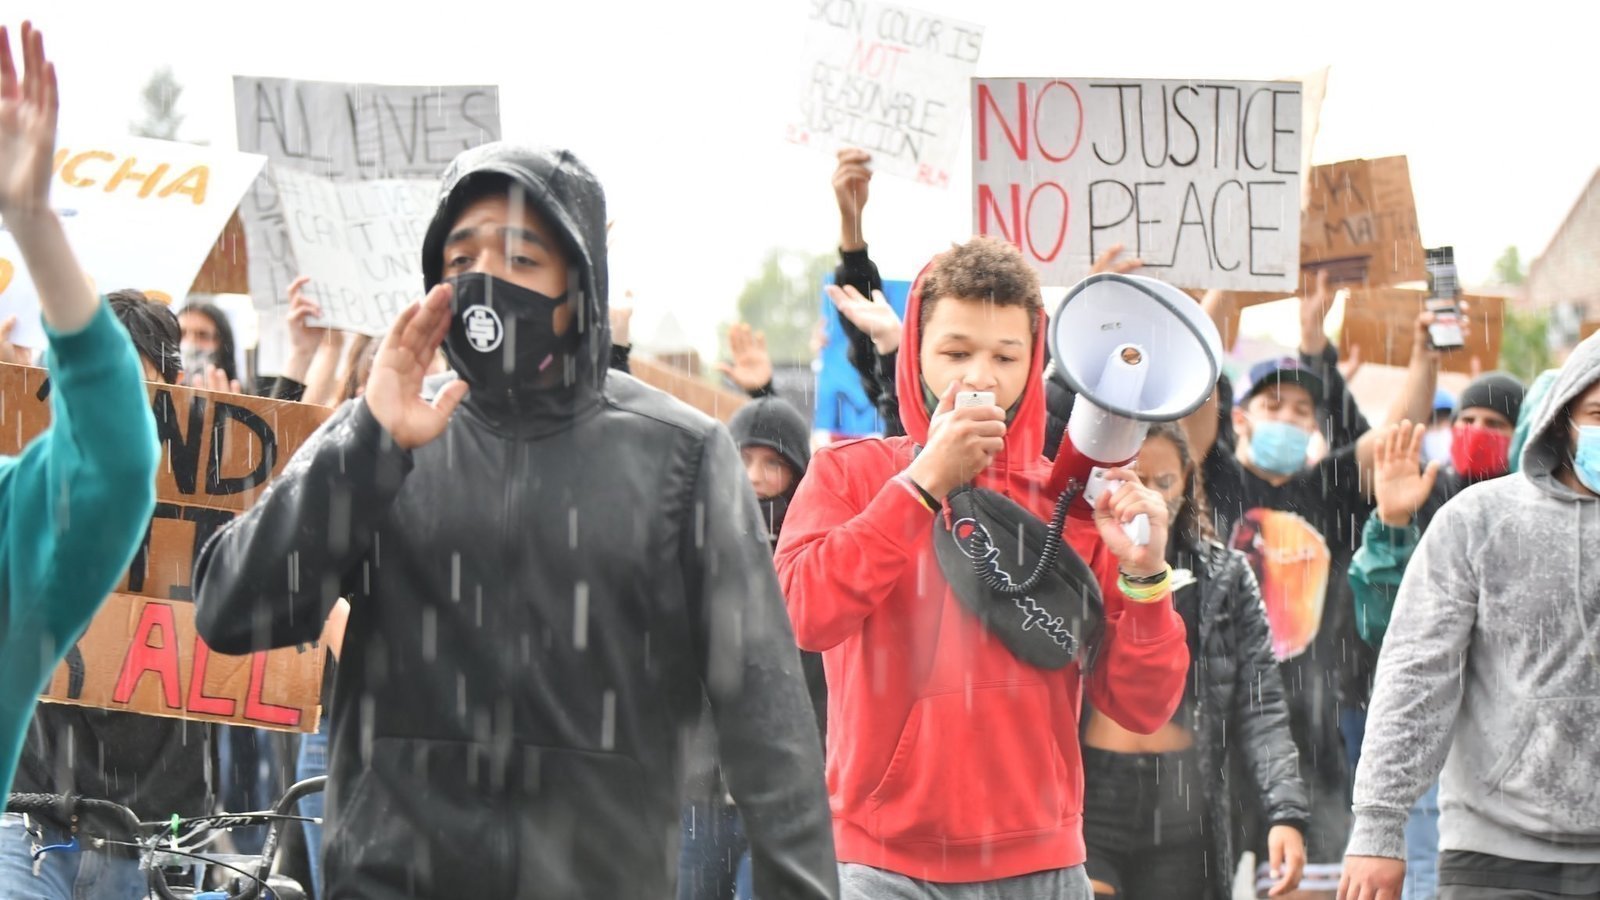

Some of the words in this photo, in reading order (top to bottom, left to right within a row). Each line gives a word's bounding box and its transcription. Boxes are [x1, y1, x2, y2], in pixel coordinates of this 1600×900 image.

[847, 37, 911, 81] NOT
[877, 8, 943, 52] COLOR
[945, 26, 983, 63] IS
[255, 82, 332, 163] ALL
[345, 89, 497, 167] LIVES
[977, 80, 1084, 163] NO
[1089, 83, 1300, 175] JUSTICE
[51, 148, 210, 206] CHA
[977, 181, 1069, 263] NO
[1089, 178, 1287, 277] PEACE
[151, 388, 278, 496] ND
[112, 601, 304, 727] ALL
